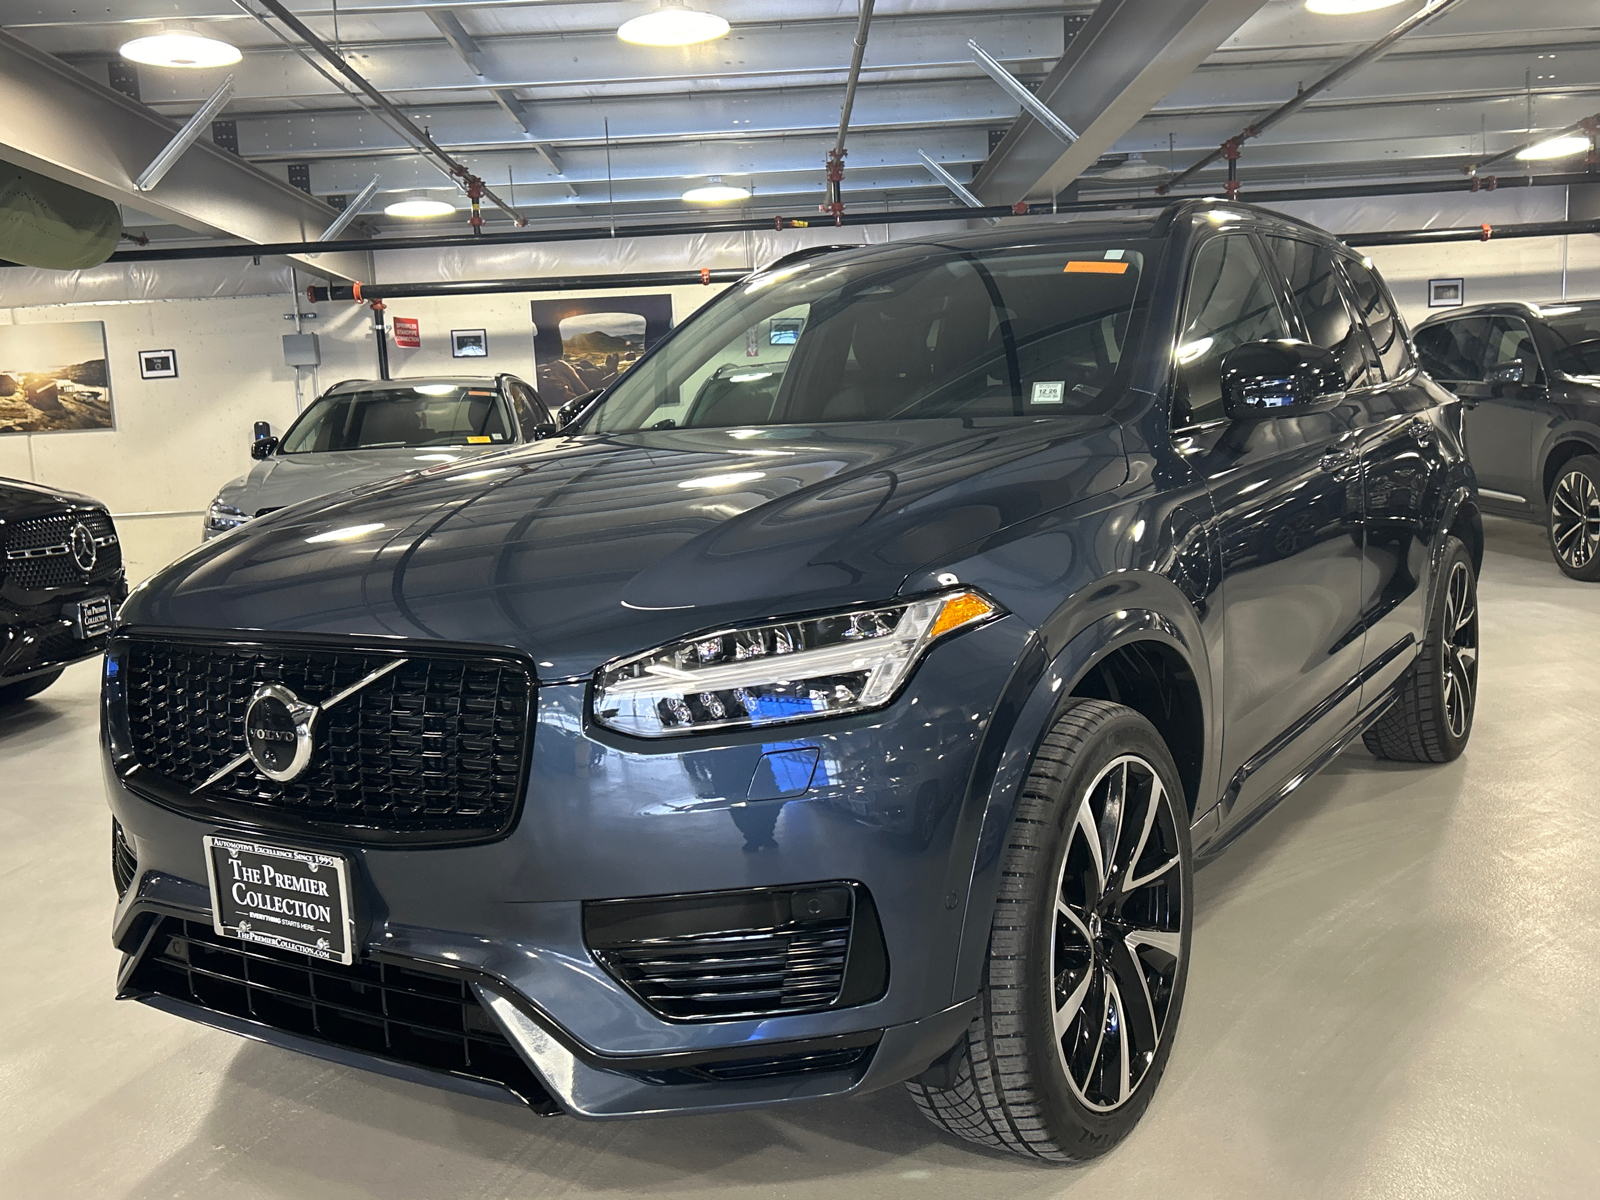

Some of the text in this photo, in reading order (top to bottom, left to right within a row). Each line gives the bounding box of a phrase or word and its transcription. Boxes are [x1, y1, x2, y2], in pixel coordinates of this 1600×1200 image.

[249, 728, 295, 742] VOLVO
[213, 838, 253, 852] AUTOMOTIVE
[254, 844, 293, 858] EXCELLENCE
[294, 852, 313, 862] SINCE
[228, 858, 330, 897] THE PREMIER
[231, 882, 331, 923] COLLECTION
[249, 911, 281, 924] EVERYTHING
[281, 918, 300, 929] STARTS
[236, 929, 330, 959] THEPREMIERCOLLECTION.COM
